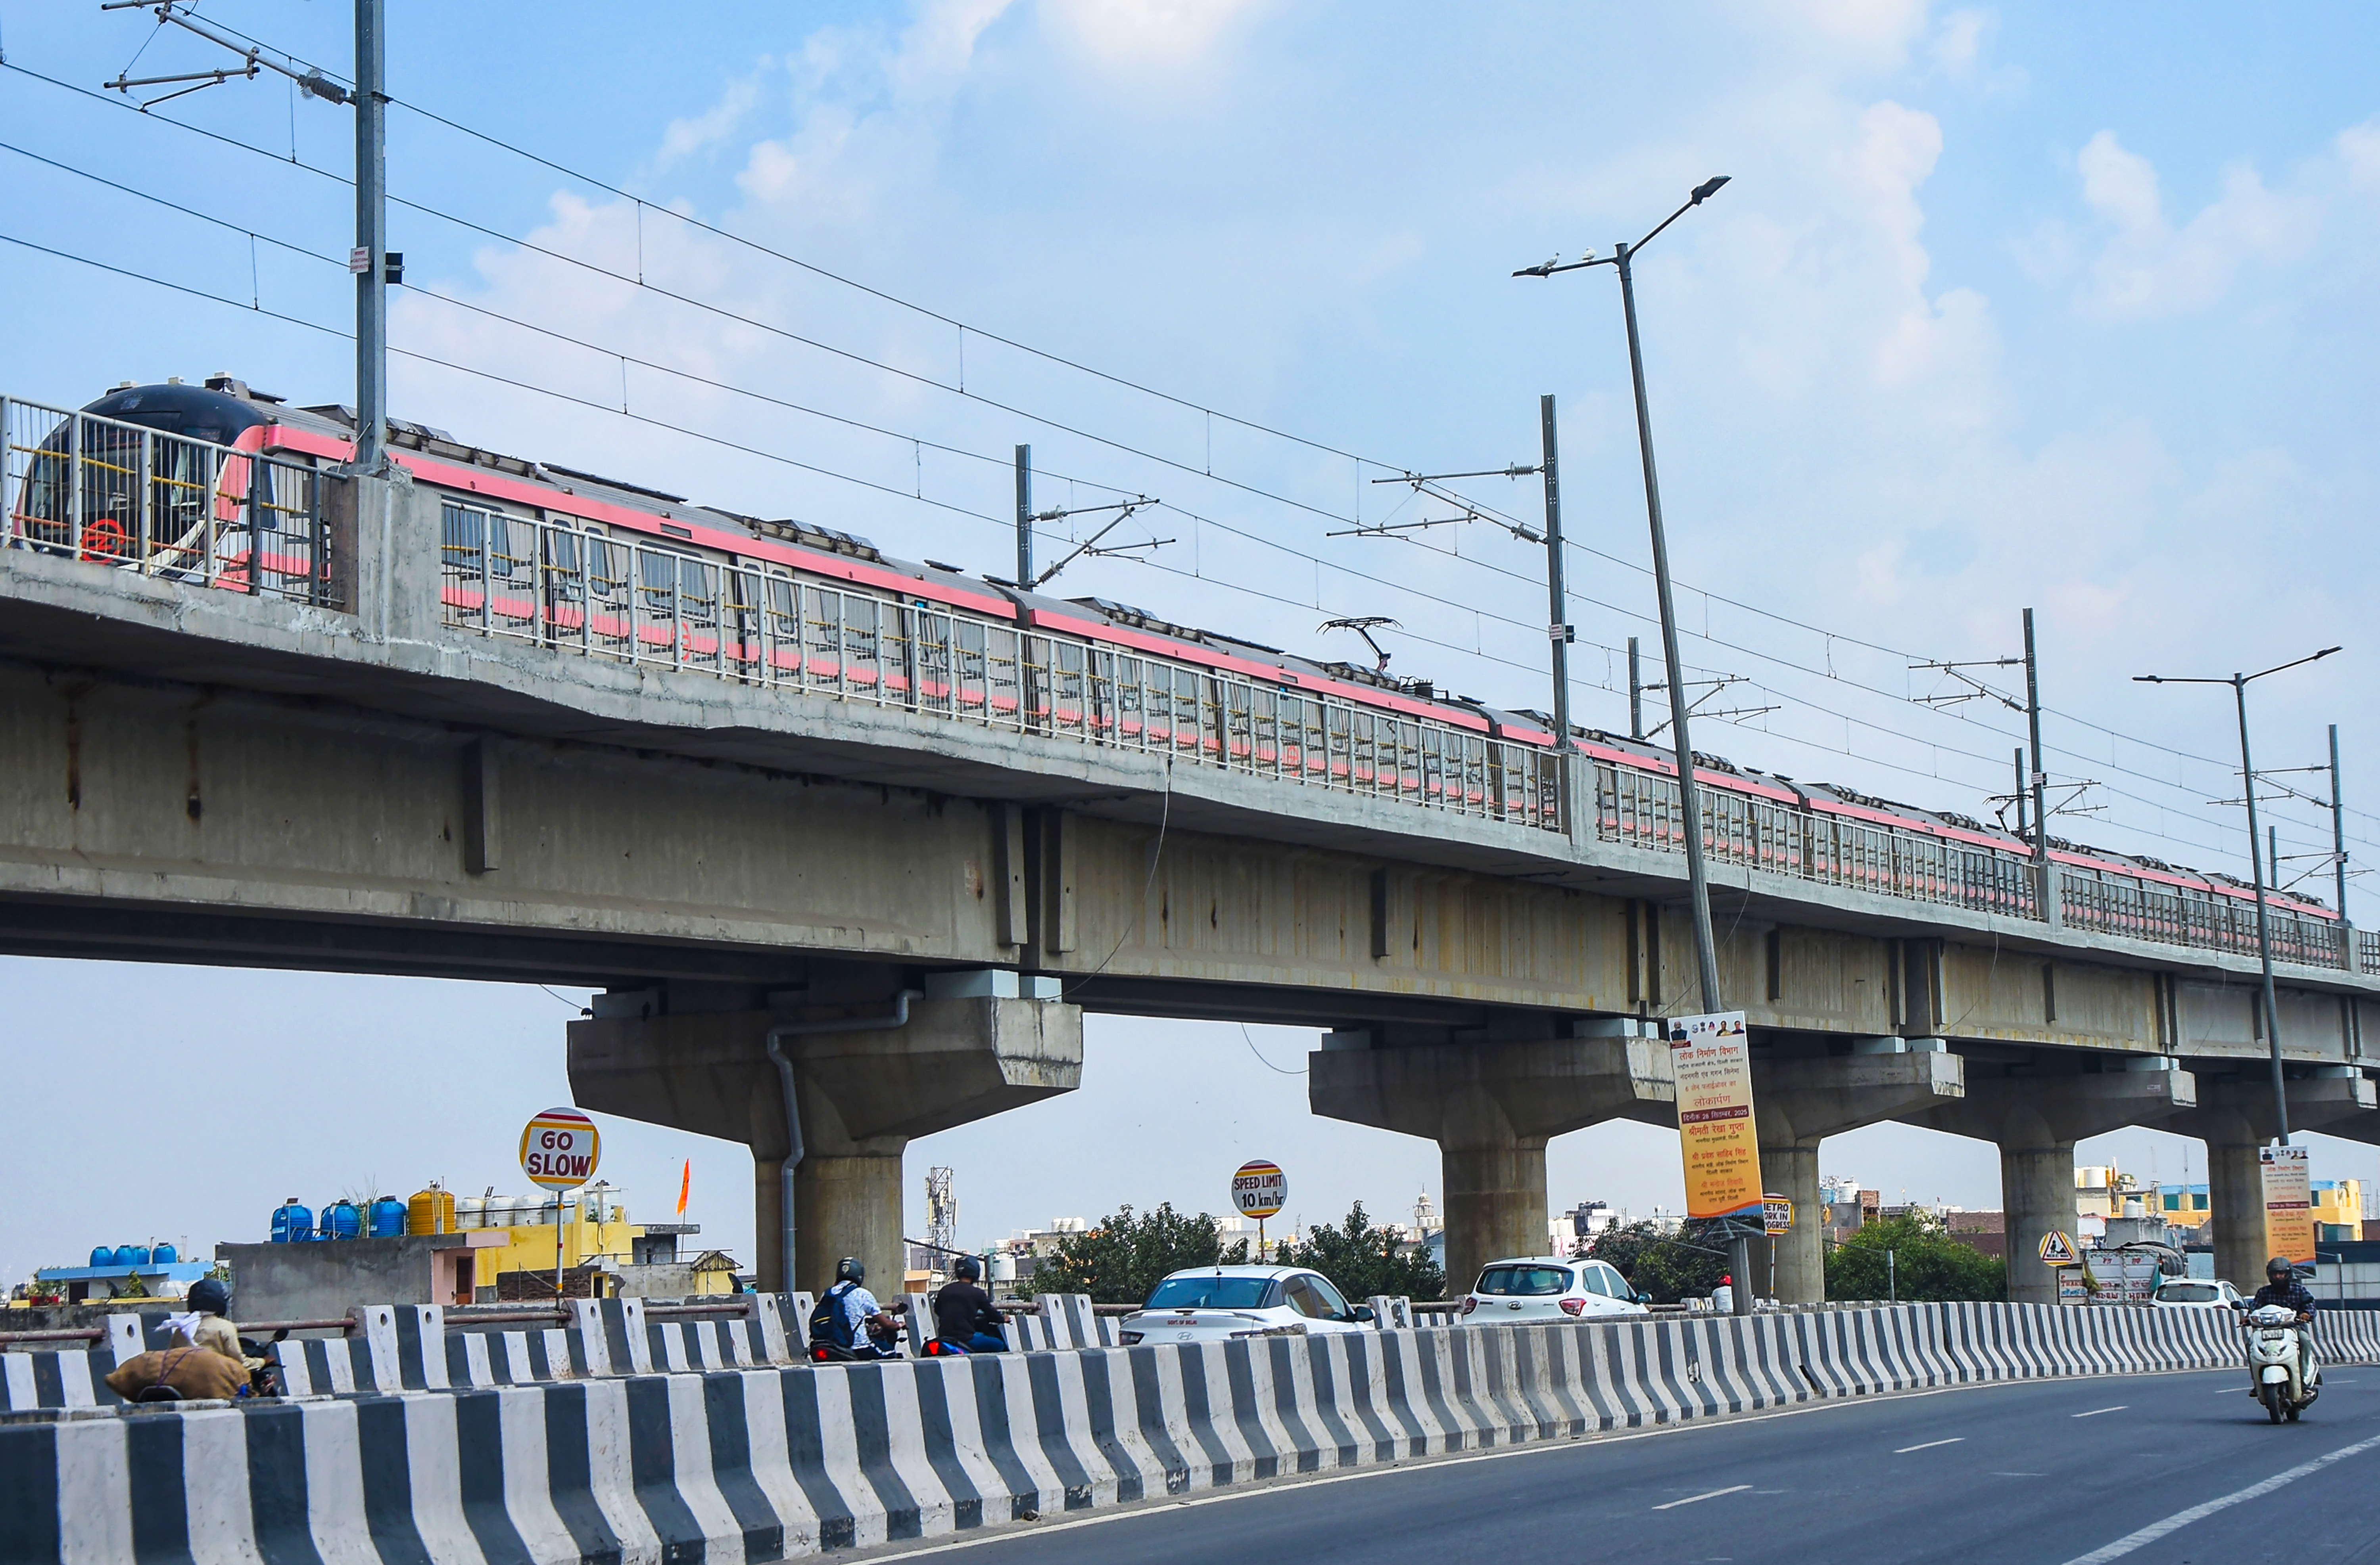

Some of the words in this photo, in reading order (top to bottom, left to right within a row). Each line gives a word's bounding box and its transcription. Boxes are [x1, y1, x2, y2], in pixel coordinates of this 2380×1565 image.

[1679, 1050, 1693, 1060] लोक
[1697, 1047, 1716, 1058] निर्माण
[1720, 1045, 1738, 1056] विभाग
[1693, 1093, 1730, 1107] लोकार्पण
[1689, 1124, 1709, 1136] श्रीमती
[1712, 1123, 1726, 1133] रेखा
[1729, 1122, 1745, 1134] गुप्ता
[541, 1131, 574, 1151] GO
[528, 1153, 592, 1176] SLOW
[1234, 1176, 1260, 1190] SPEED
[1262, 1174, 1282, 1188] LIMIT
[1242, 1193, 1255, 1208] 10
[1258, 1191, 1284, 1206] km/hr
